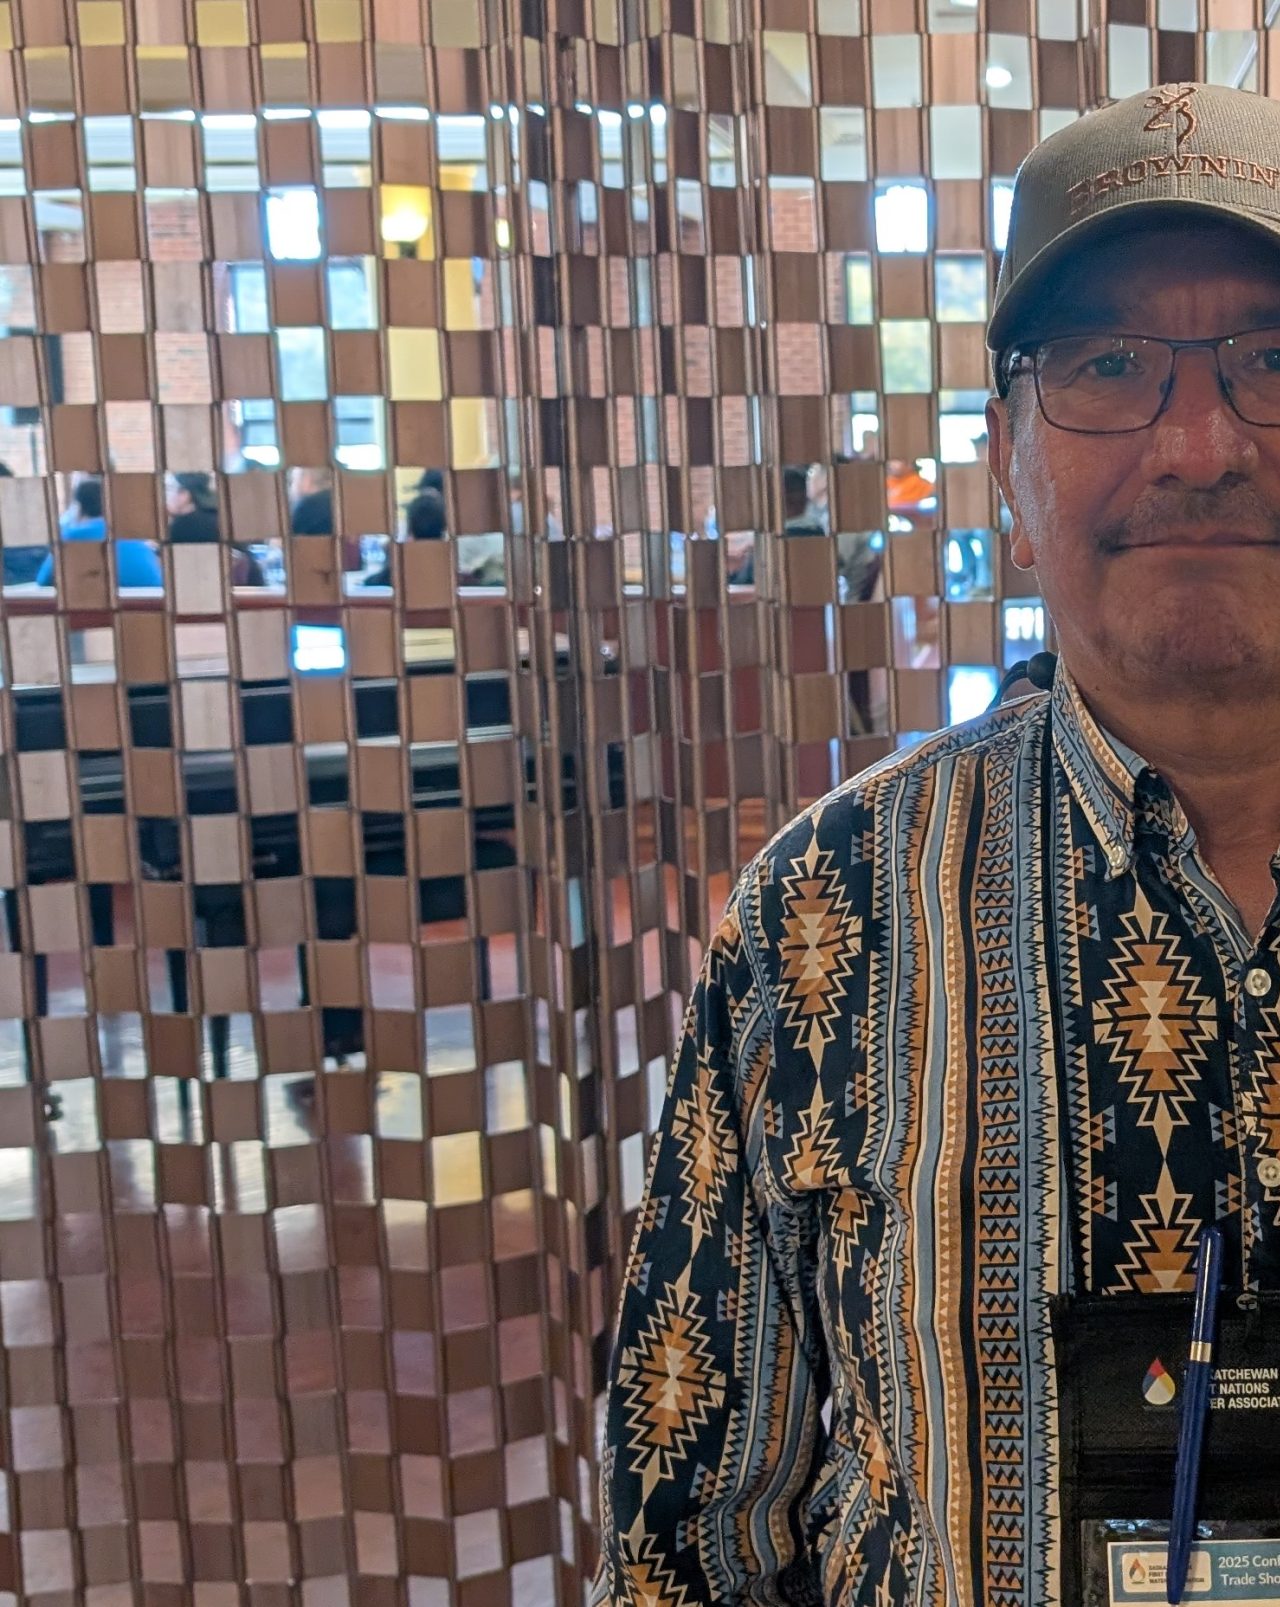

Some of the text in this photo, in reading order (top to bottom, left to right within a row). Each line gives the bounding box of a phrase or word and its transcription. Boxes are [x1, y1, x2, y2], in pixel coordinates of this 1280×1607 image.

[1209, 1368, 1279, 1380] ATCHEWAN
[1219, 1382, 1270, 1395] NATIONS
[1218, 1555, 1249, 1569] 2025
[1220, 1572, 1256, 1586] Trade
